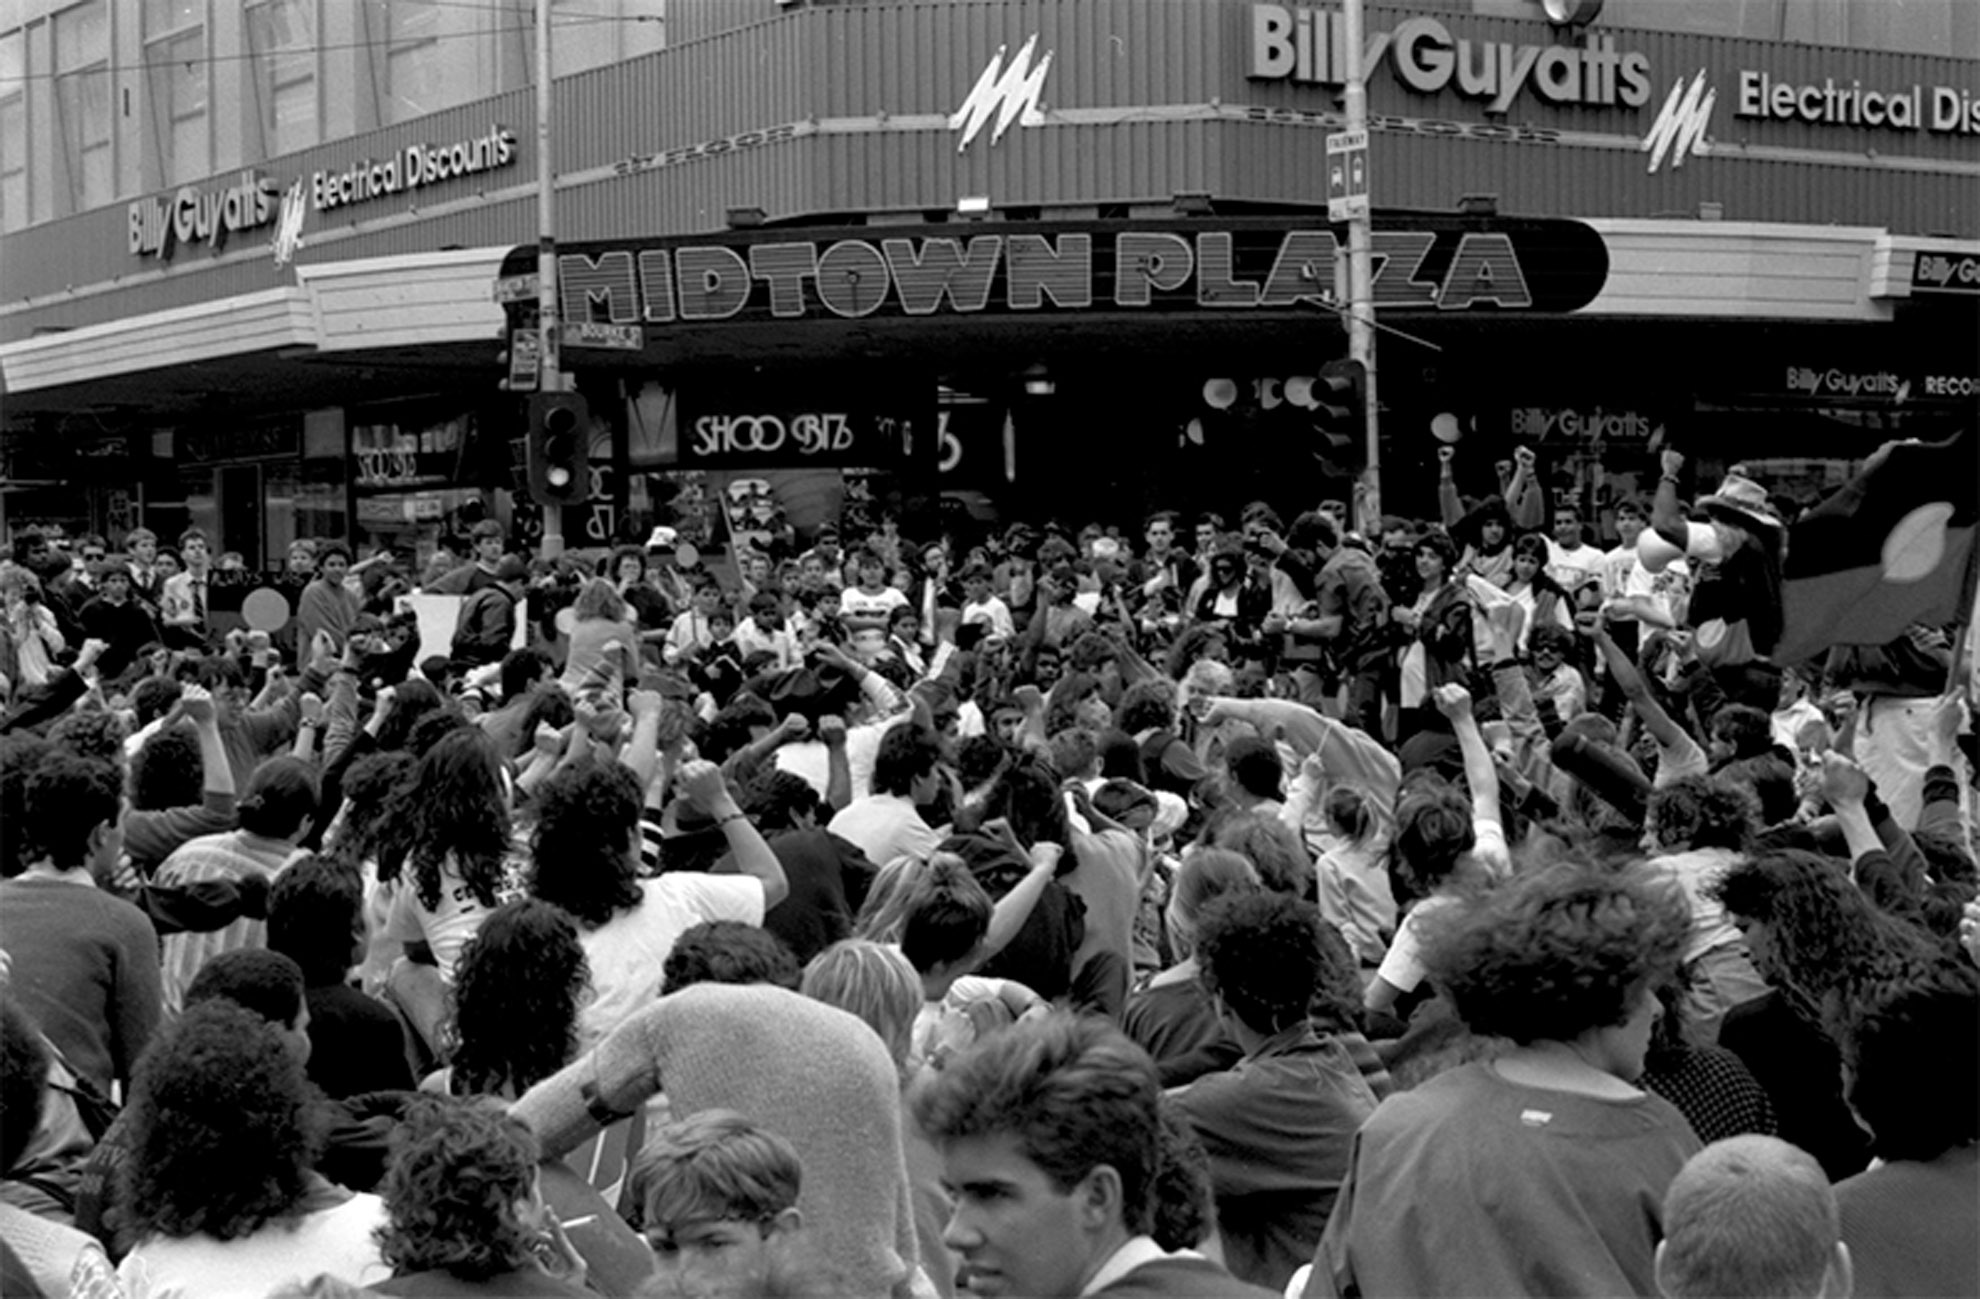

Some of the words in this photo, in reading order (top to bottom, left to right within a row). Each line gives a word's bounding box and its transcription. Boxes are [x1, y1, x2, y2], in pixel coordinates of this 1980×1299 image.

[1395, 16, 1652, 114] Guyatts
[1739, 70, 1921, 128] Electrical
[313, 150, 402, 209] Electrical
[406, 123, 514, 187] Discounts
[129, 196, 172, 259] Billy
[173, 169, 277, 248] Guyatts
[557, 234, 1092, 323] MIDTOWN
[1114, 231, 1533, 309] PLAZA
[1787, 366, 1824, 396] Billy
[1825, 368, 1900, 397] Guyatts
[693, 413, 785, 456] SHOO
[1511, 408, 1559, 442] Billy
[1558, 410, 1650, 442] Guyatts
